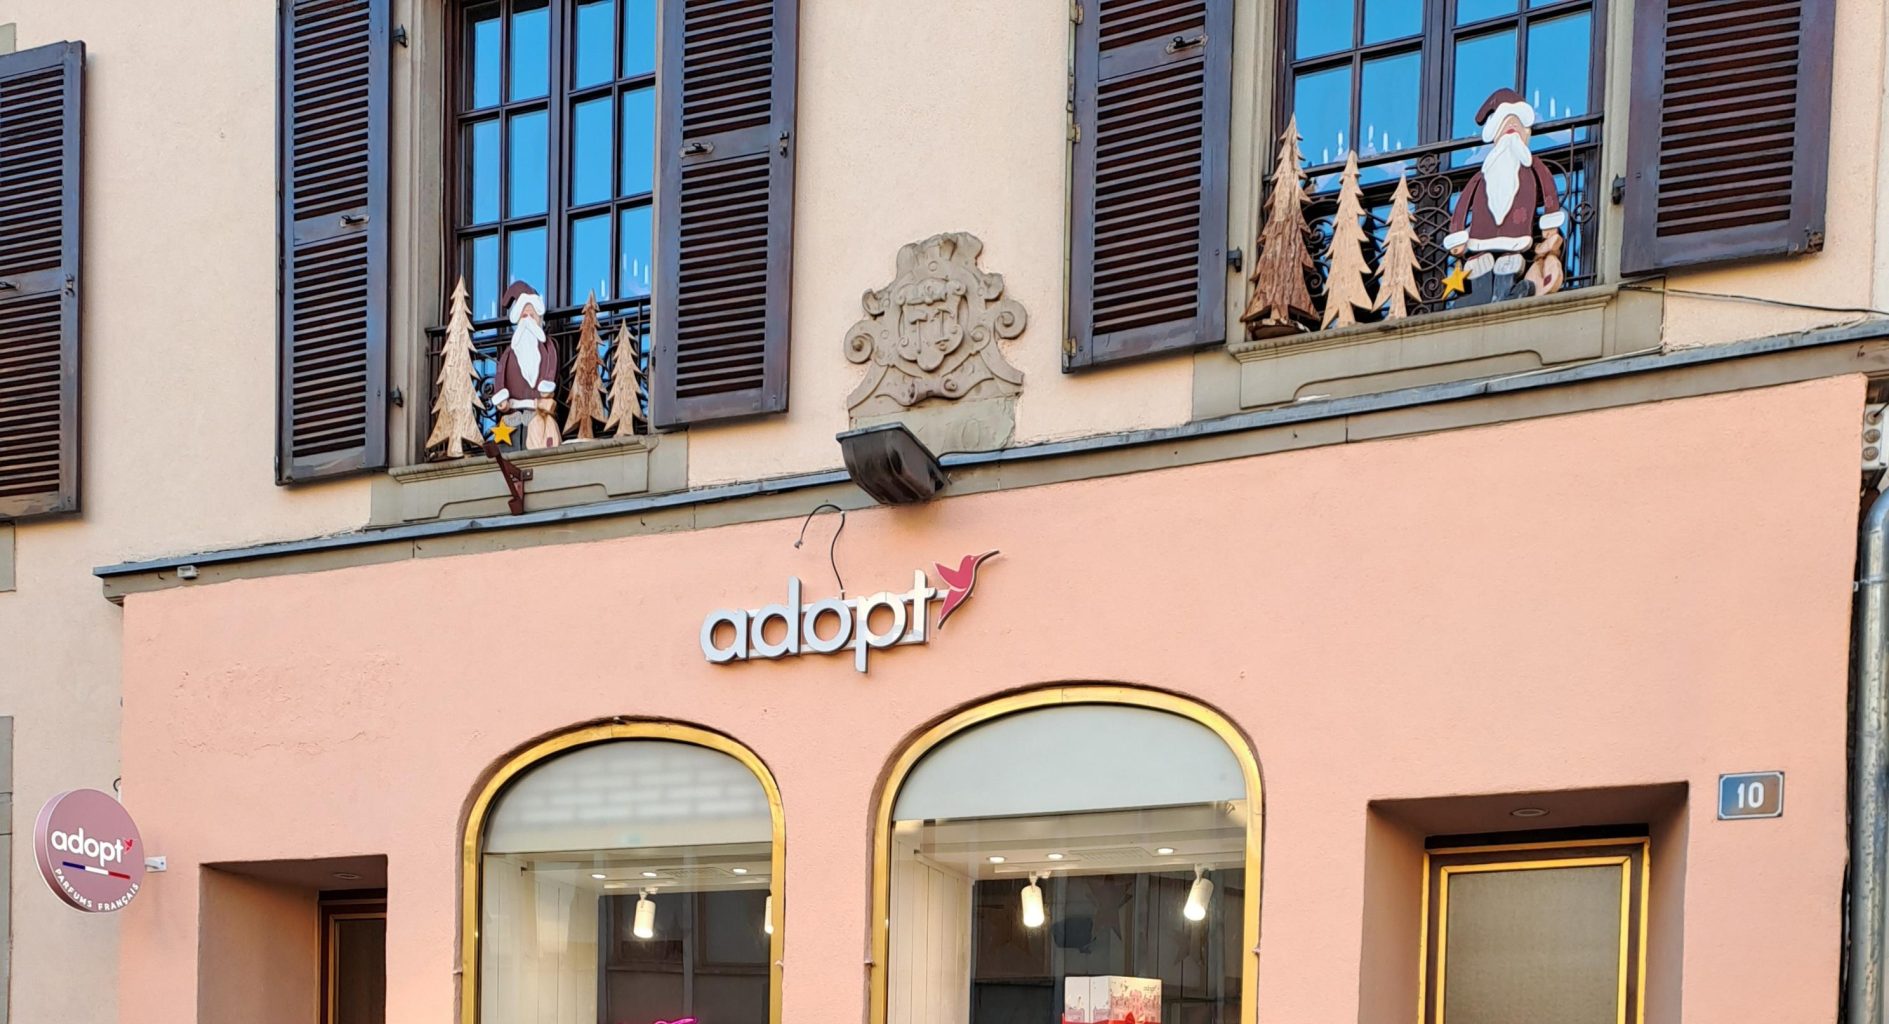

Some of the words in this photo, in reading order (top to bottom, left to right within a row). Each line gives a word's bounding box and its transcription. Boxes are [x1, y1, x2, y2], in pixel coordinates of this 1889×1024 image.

[700, 569, 936, 673] adopt
[1736, 782, 1764, 808] 10
[51, 827, 124, 867] adopt
[54, 868, 93, 908] PARFUMS
[97, 882, 139, 911] FRANÇAIS
